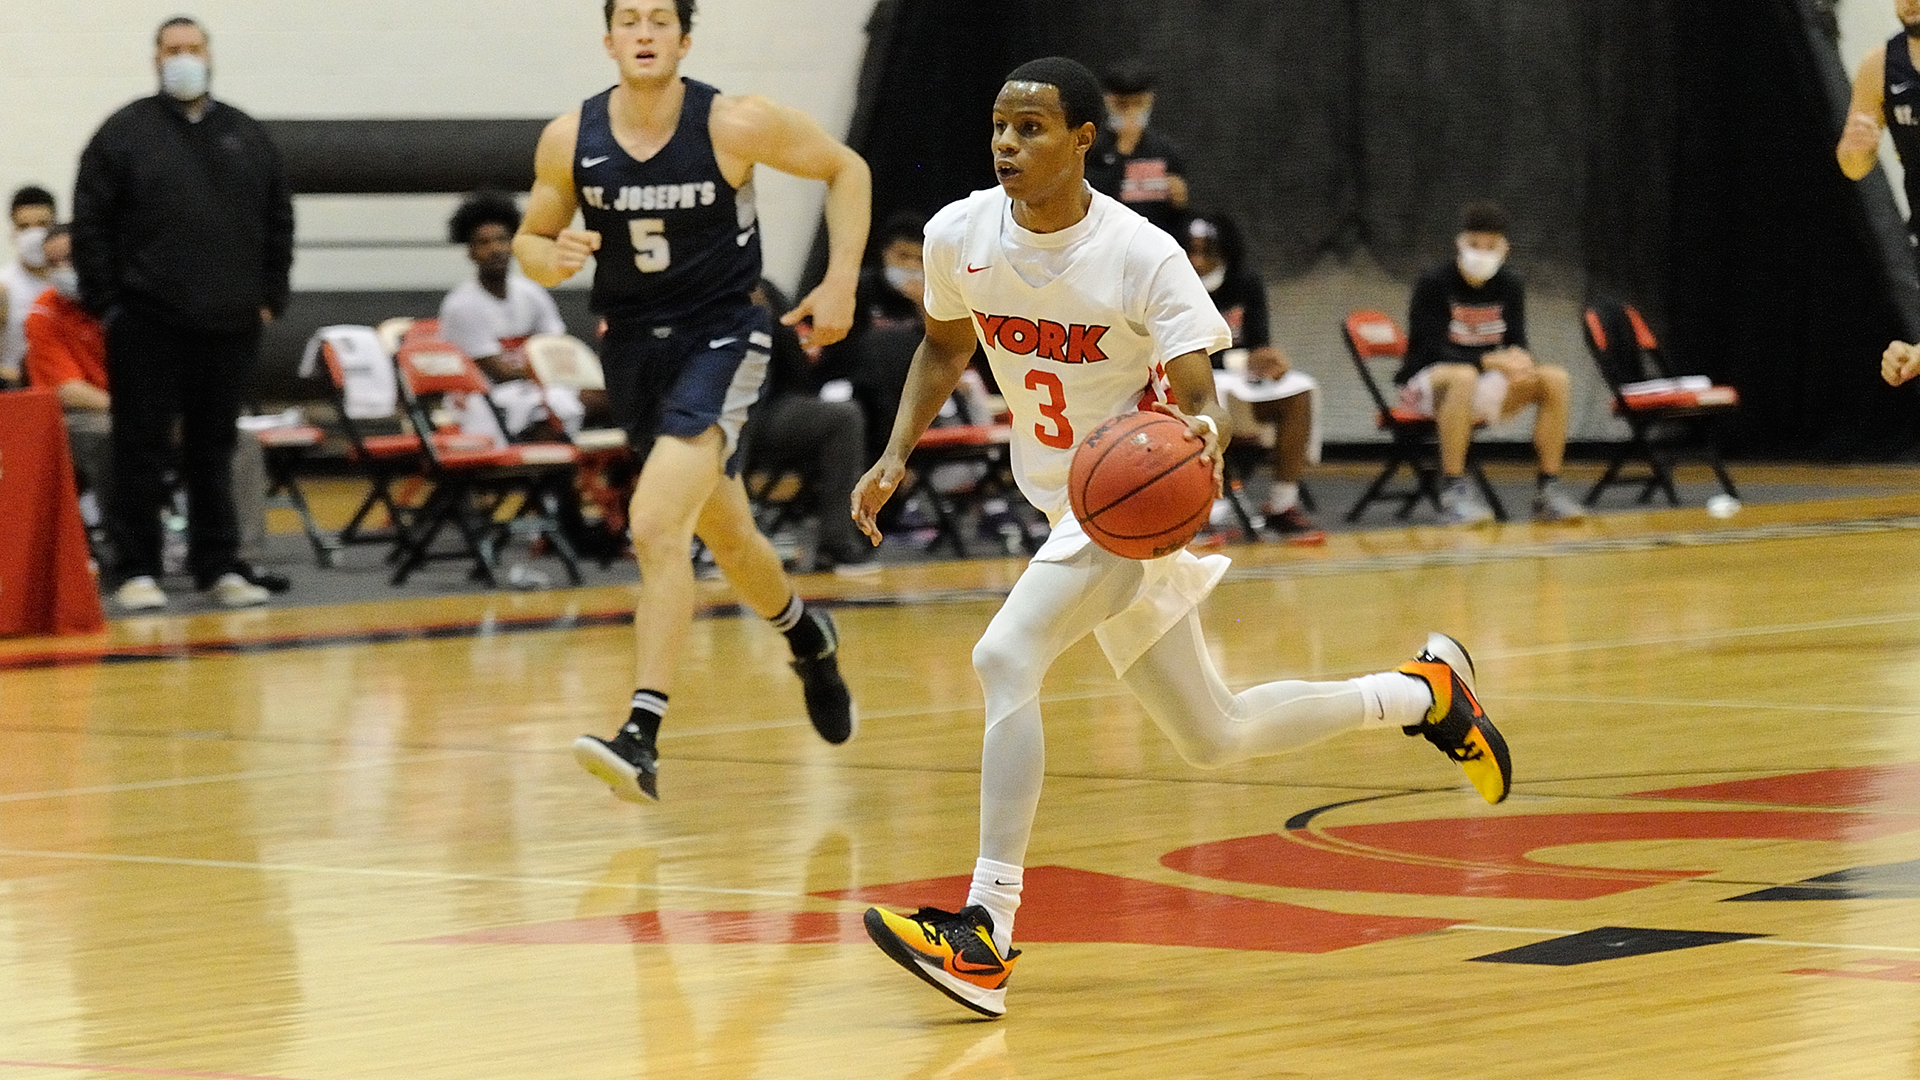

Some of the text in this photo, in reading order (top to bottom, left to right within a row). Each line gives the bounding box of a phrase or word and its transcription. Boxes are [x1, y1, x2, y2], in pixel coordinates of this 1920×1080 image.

[613, 181, 716, 211] JOSEPH'S
[628, 218, 671, 274] 5
[972, 309, 1111, 364] YORK
[1024, 368, 1074, 449] 3
